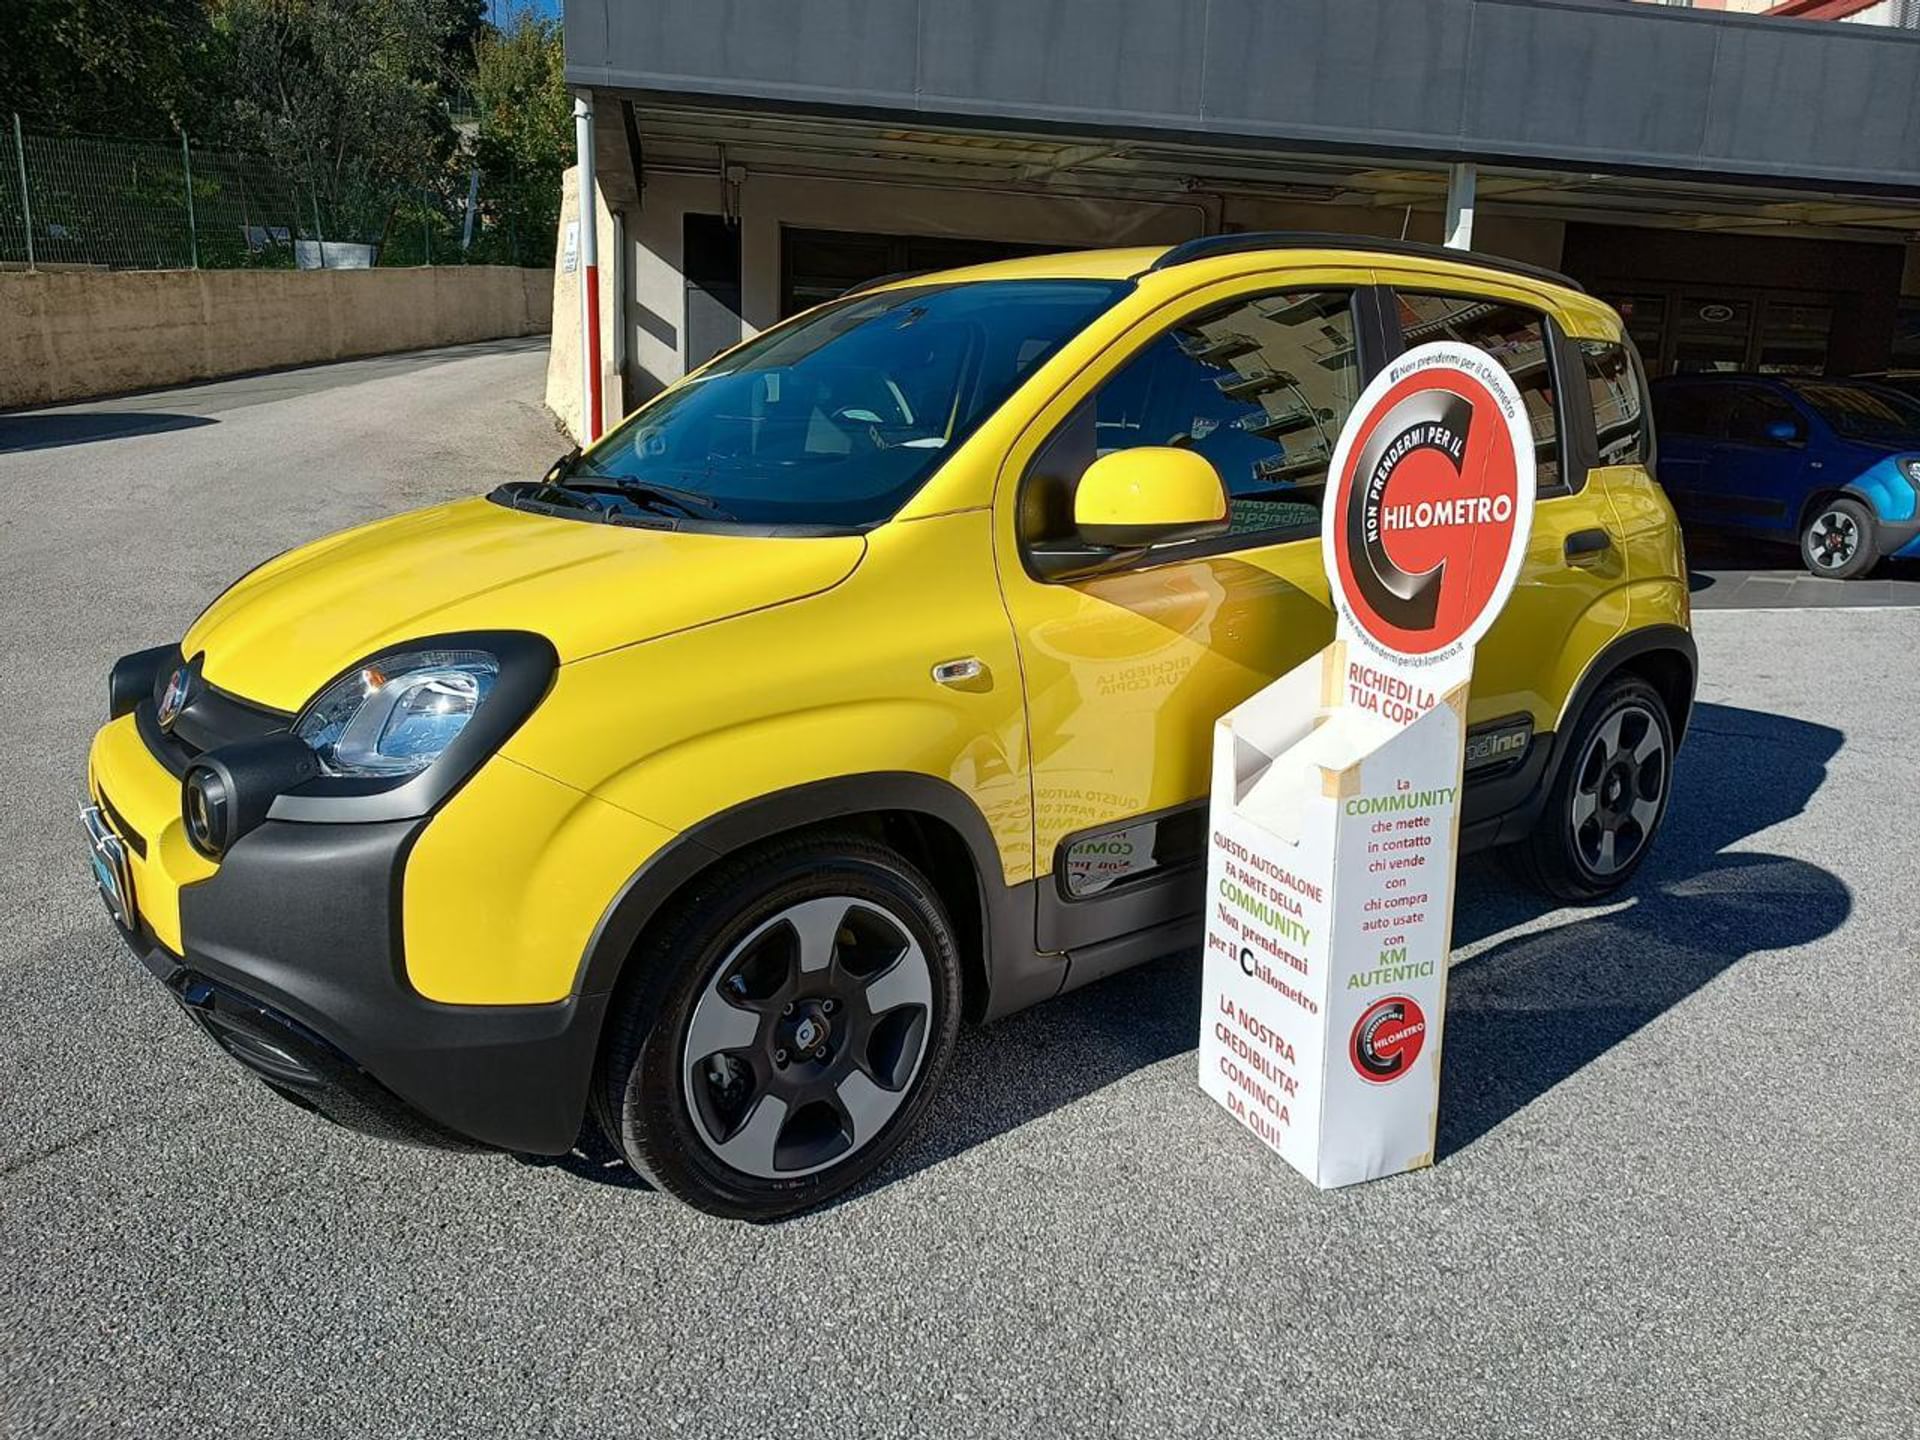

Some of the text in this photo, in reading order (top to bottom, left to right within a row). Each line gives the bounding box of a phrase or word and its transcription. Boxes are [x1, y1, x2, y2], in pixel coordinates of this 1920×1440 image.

[1399, 361, 1416, 374] Non
[1417, 352, 1461, 370] prendermi
[1460, 357, 1476, 370] per
[1480, 366, 1516, 419] Chilometro
[1367, 426, 1464, 543] NON PRENDERMI PER IL
[1349, 662, 1436, 711] RICHIEDI LA
[1350, 684, 1419, 726] TUA COP
[1345, 787, 1457, 816] COMMUNITY
[1396, 778, 1411, 791] La
[1367, 835, 1432, 853] in contatto
[1371, 815, 1431, 833] che mette
[1213, 831, 1323, 904] QUESTO AUTOSALONE
[1368, 854, 1425, 873] chi vende
[1385, 878, 1407, 889] con
[1225, 860, 1303, 918] FA PARTE DELLA
[1363, 893, 1428, 912] chi compra
[1219, 878, 1310, 947] COMMUNITY
[1362, 912, 1425, 932] auto usate
[1216, 902, 1310, 976] Non prendermi
[1379, 947, 1407, 966] KM
[1383, 934, 1405, 947] con
[1208, 932, 1319, 1016] per il Chilometro
[1346, 959, 1435, 990] AUTENTICI
[1219, 993, 1296, 1066] LA NOSTRA
[1214, 1021, 1300, 1098] CREDIBILITA'
[1220, 1055, 1291, 1127] COMINCIA
[1226, 1090, 1282, 1150] DA QUI!
